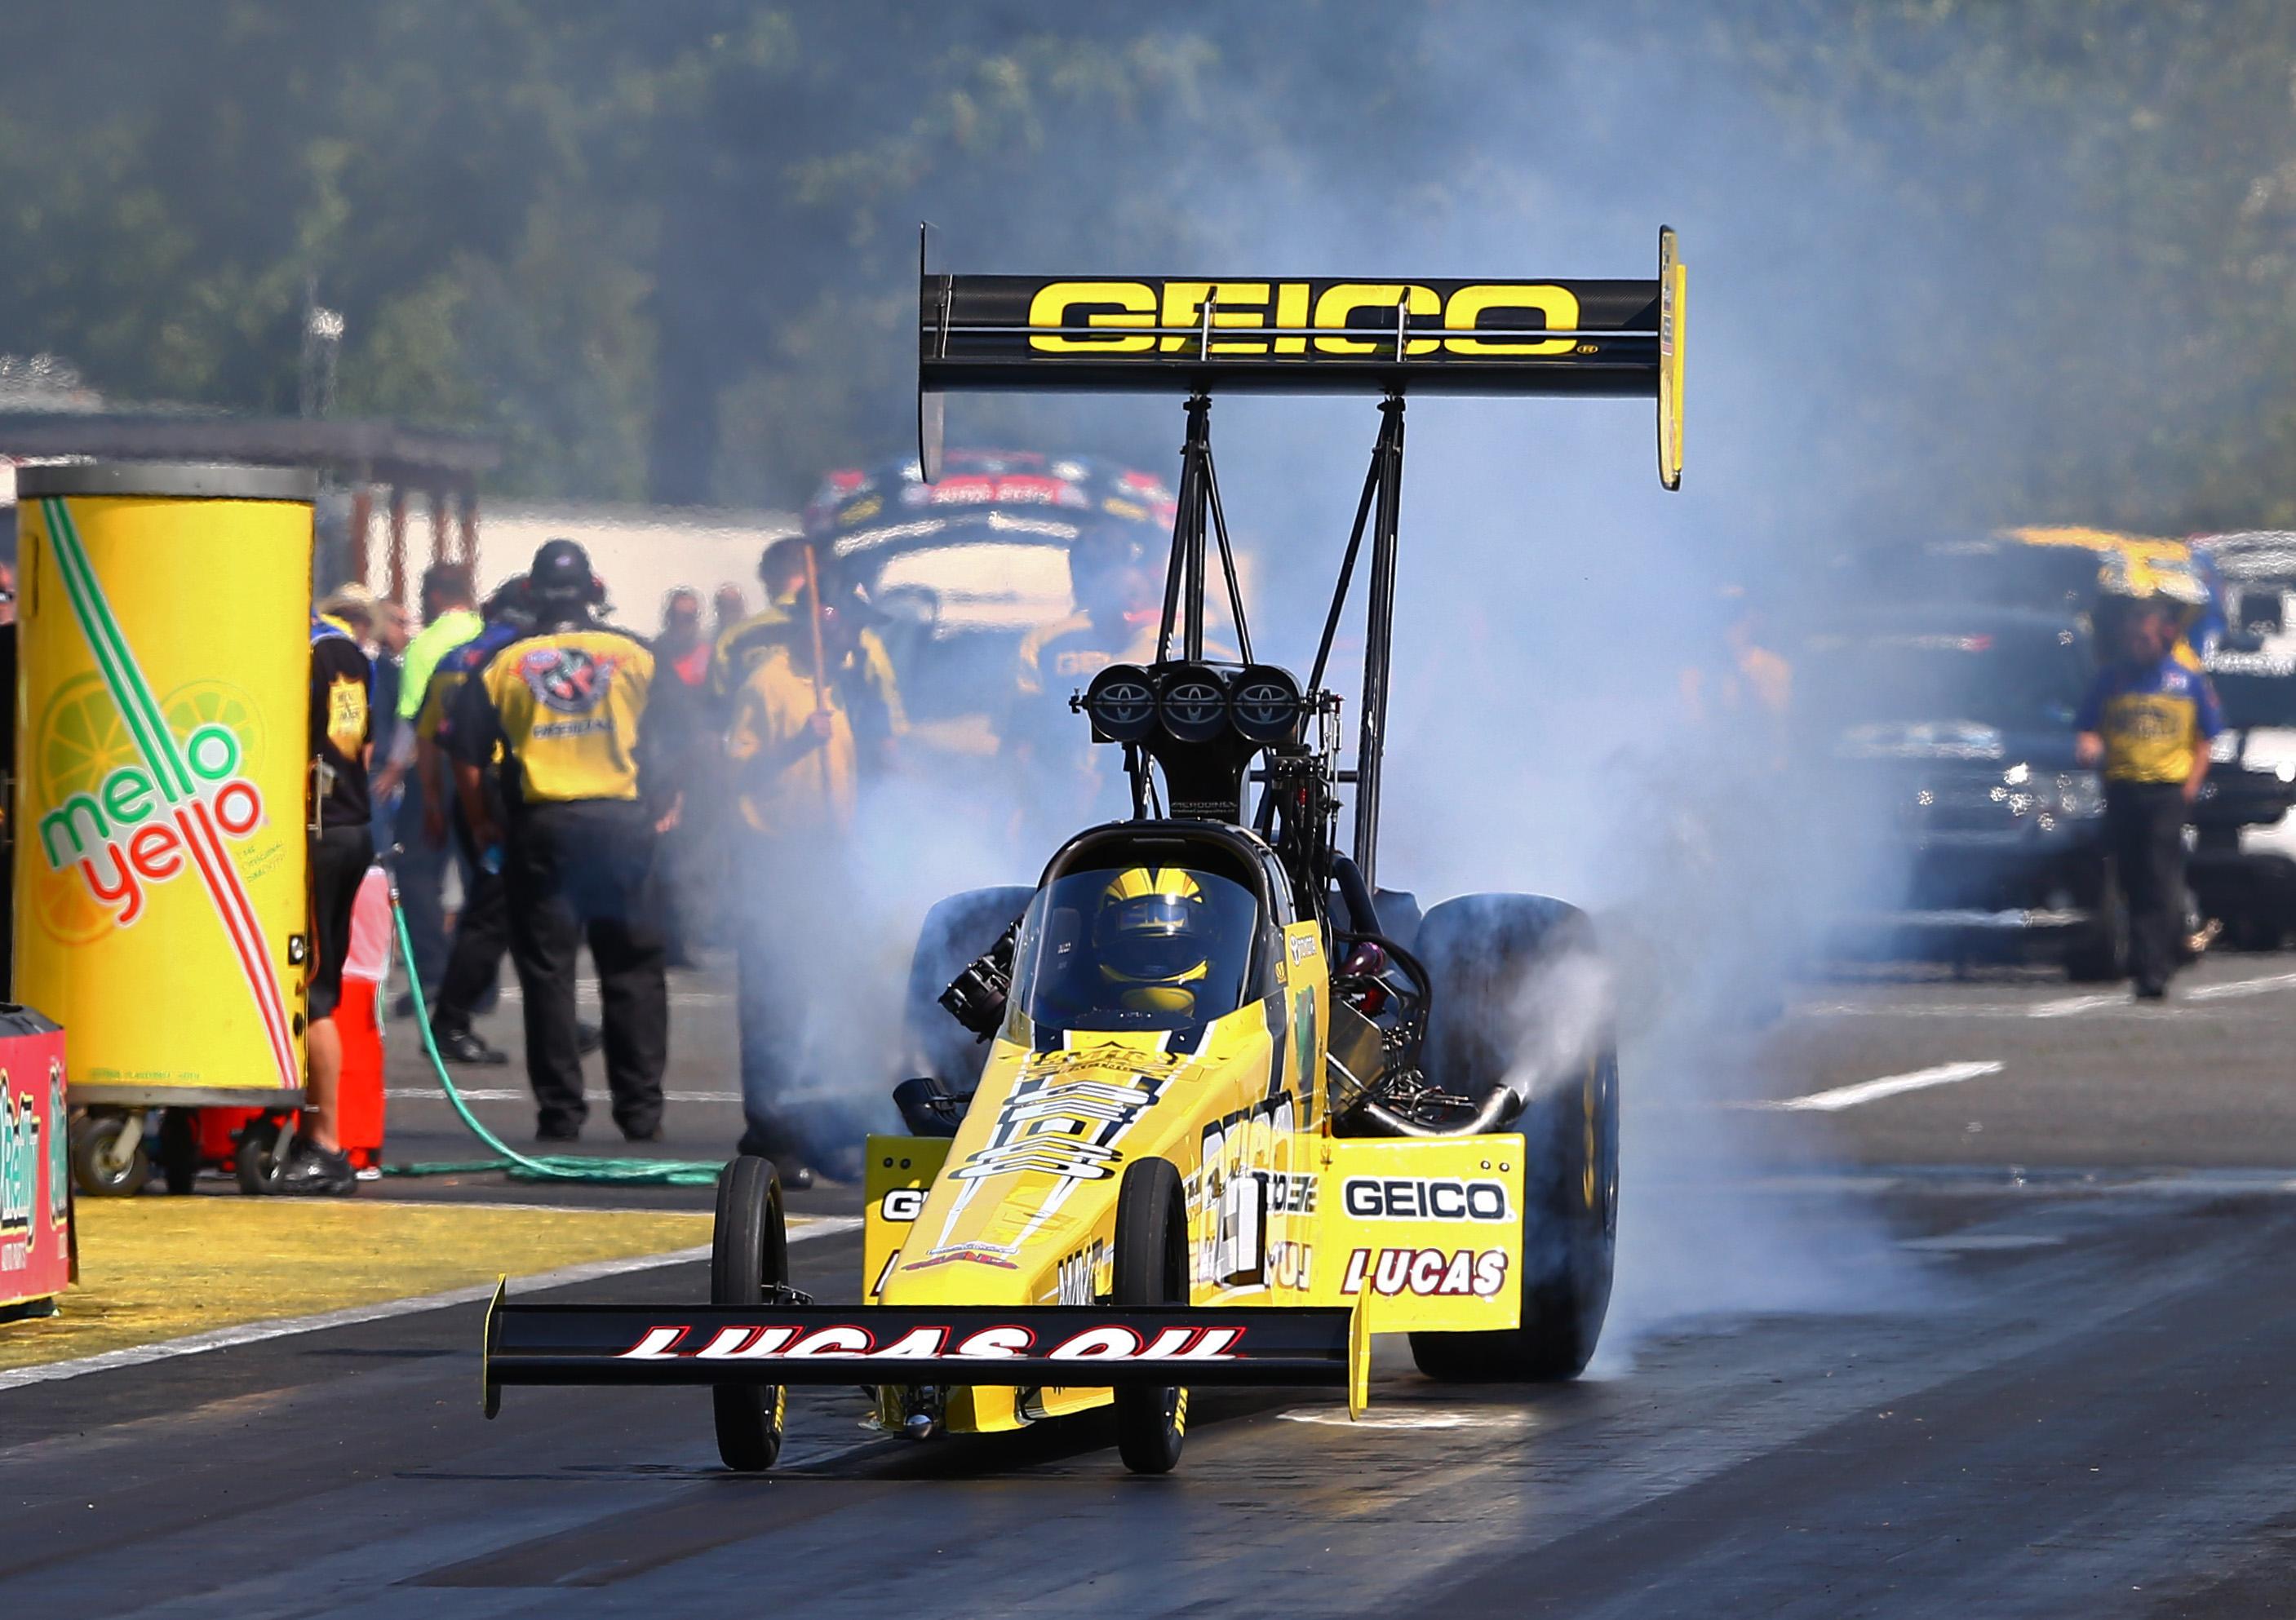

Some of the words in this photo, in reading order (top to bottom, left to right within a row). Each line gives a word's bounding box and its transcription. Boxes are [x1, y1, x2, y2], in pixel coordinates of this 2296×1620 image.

[1027, 281, 1580, 356] GEICO
[39, 725, 238, 868] mello
[79, 781, 260, 923] yello
[1344, 1180, 1507, 1221] GEICO
[1341, 1247, 1509, 1297] LUCAS
